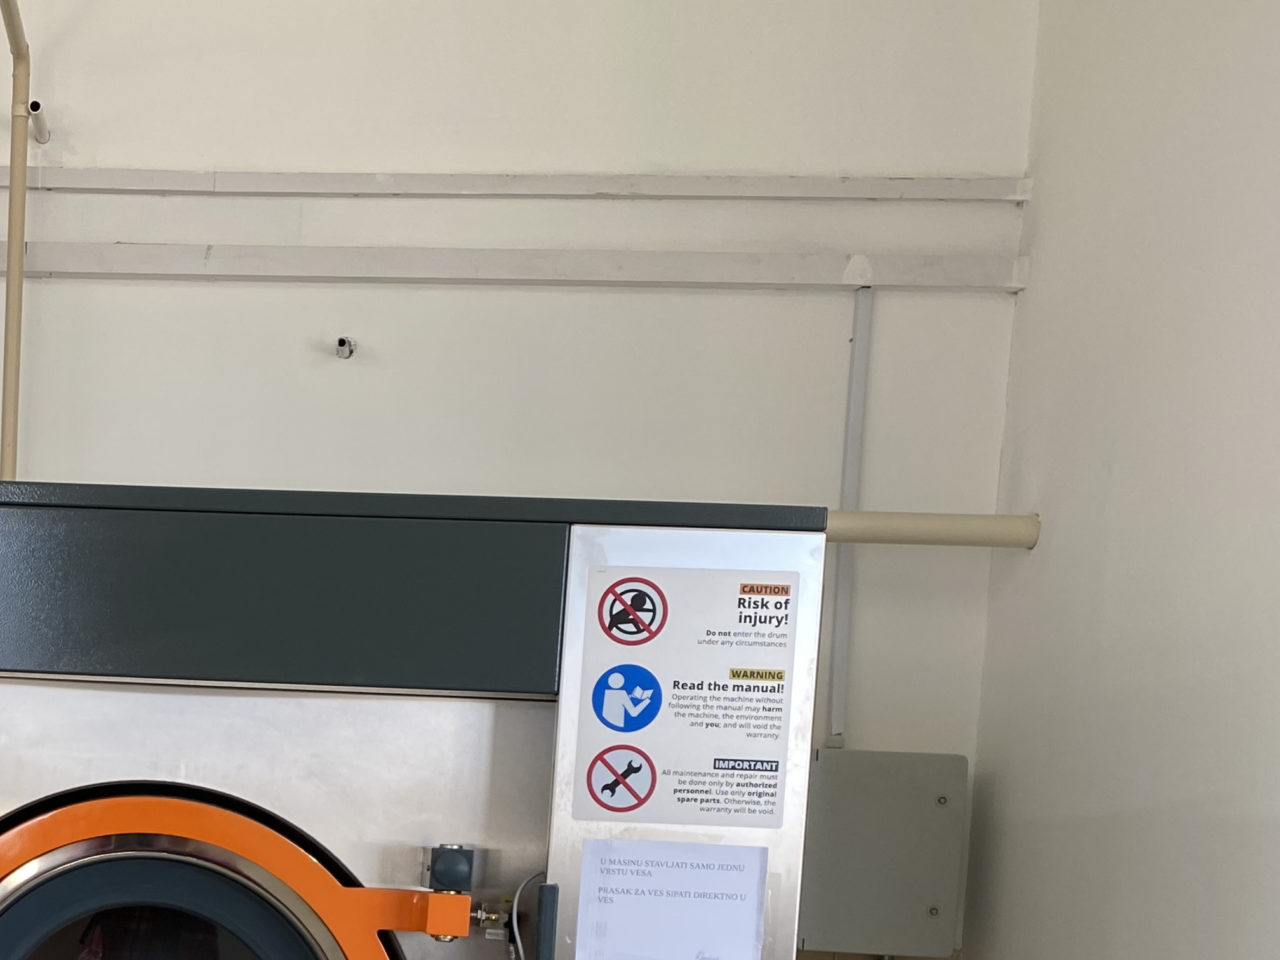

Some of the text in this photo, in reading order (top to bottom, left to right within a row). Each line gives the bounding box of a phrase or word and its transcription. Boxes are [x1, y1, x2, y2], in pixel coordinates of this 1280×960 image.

[742, 585, 789, 595] CAUTION
[738, 597, 790, 610] Risk of
[739, 612, 788, 627] injury!
[731, 670, 784, 679] WARNING
[673, 681, 784, 693] Read the manual!
[672, 693, 707, 702] Operating
[723, 695, 753, 703] machine
[755, 696, 783, 704] without
[668, 702, 700, 711] following
[715, 760, 778, 770] IMPORTANT
[737, 772, 757, 780] repair
[708, 780, 723, 788] only
[725, 780, 734, 788] by
[735, 781, 777, 789] authorized
[731, 790, 746, 798] only
[700, 807, 732, 815] warranty
[645, 860, 688, 869] STAVLJATI
[690, 862, 715, 871] SAMO
[717, 864, 745, 872] JEDNU
[600, 868, 628, 876] VRSTU
[634, 888, 646, 896] ZA
[666, 890, 691, 898] SIPATI
[693, 891, 738, 901] DIREKTNO
